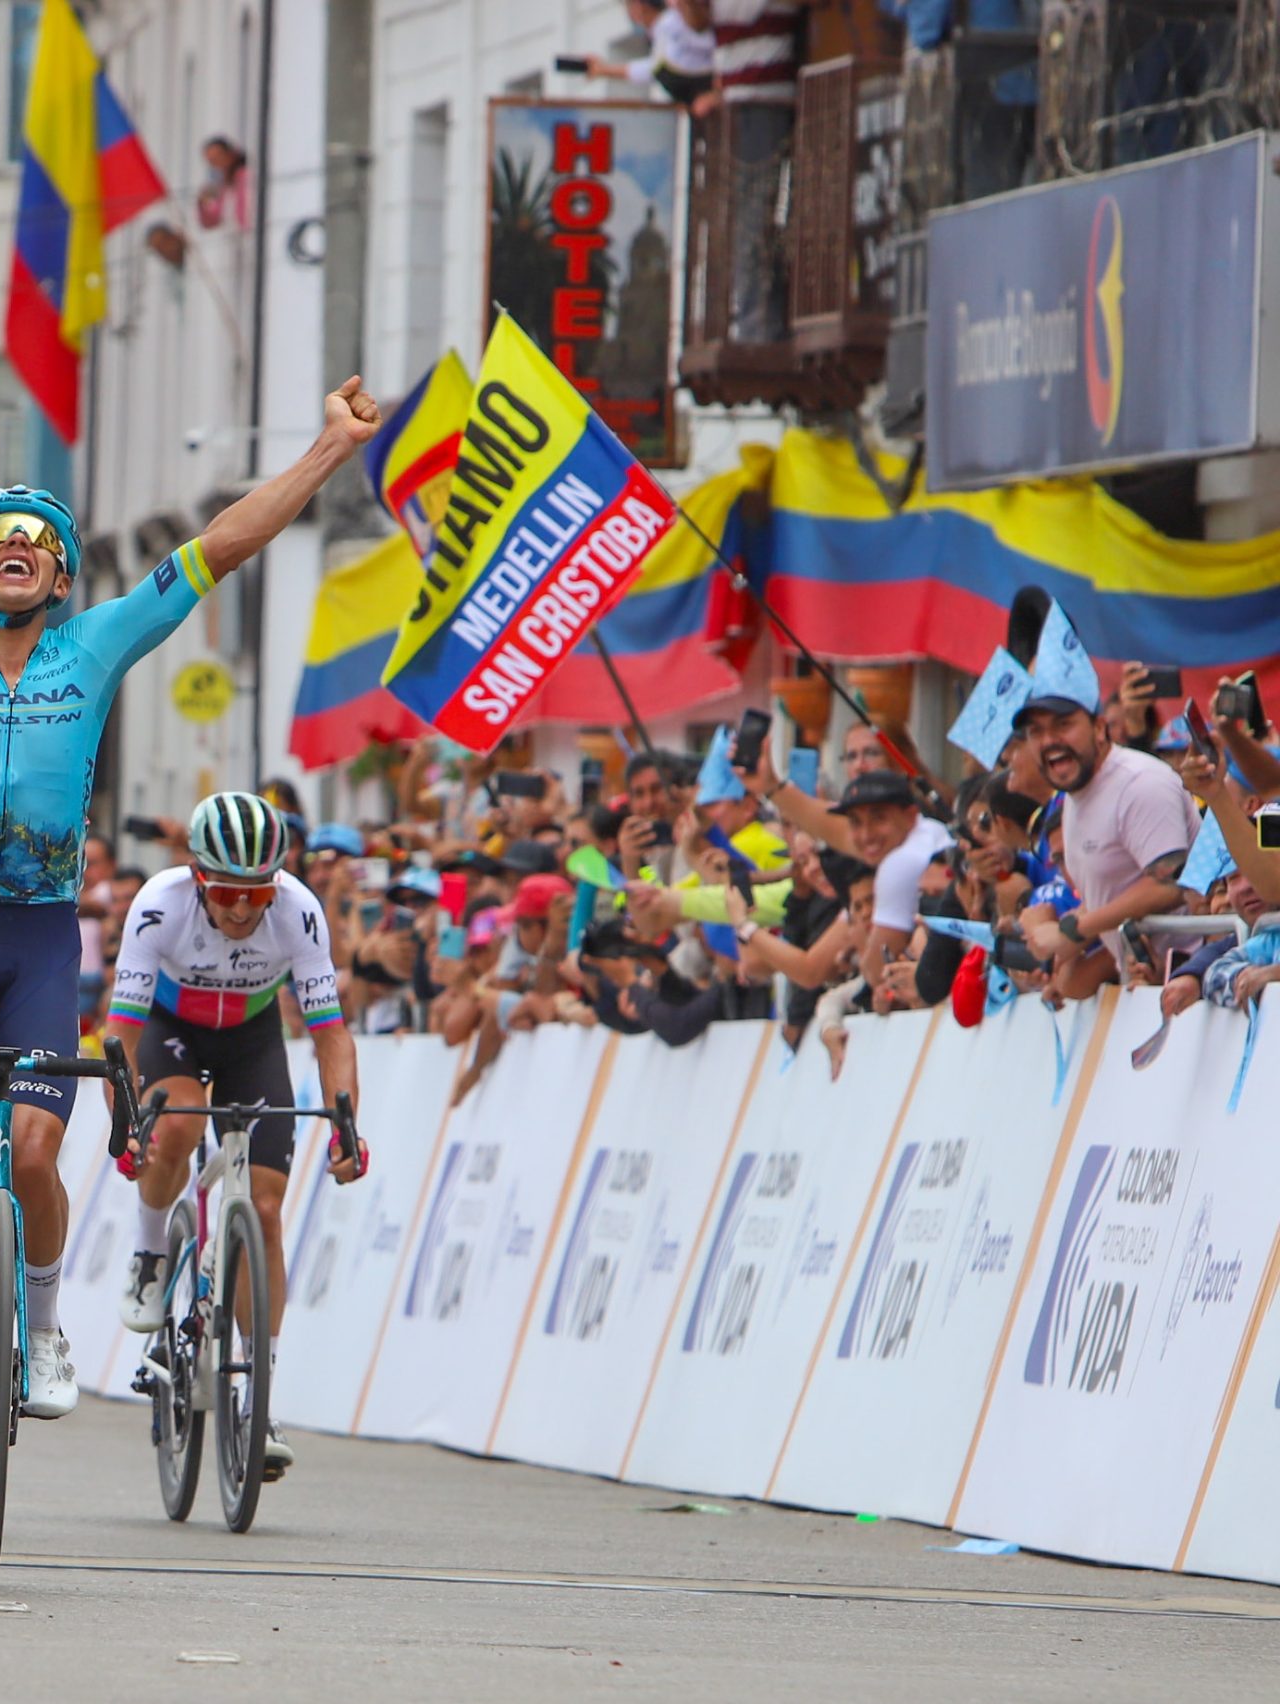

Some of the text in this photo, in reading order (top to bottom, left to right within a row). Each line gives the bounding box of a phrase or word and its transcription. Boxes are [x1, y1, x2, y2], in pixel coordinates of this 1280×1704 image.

[550, 121, 612, 391] HOTEL
[450, 472, 604, 653] MEDELLIN
[462, 641, 544, 725] SAN
[1117, 1146, 1180, 1204] COLOMBIA
[1192, 1243, 1242, 1317] Deporte
[1068, 1279, 1138, 1395] VIDA
